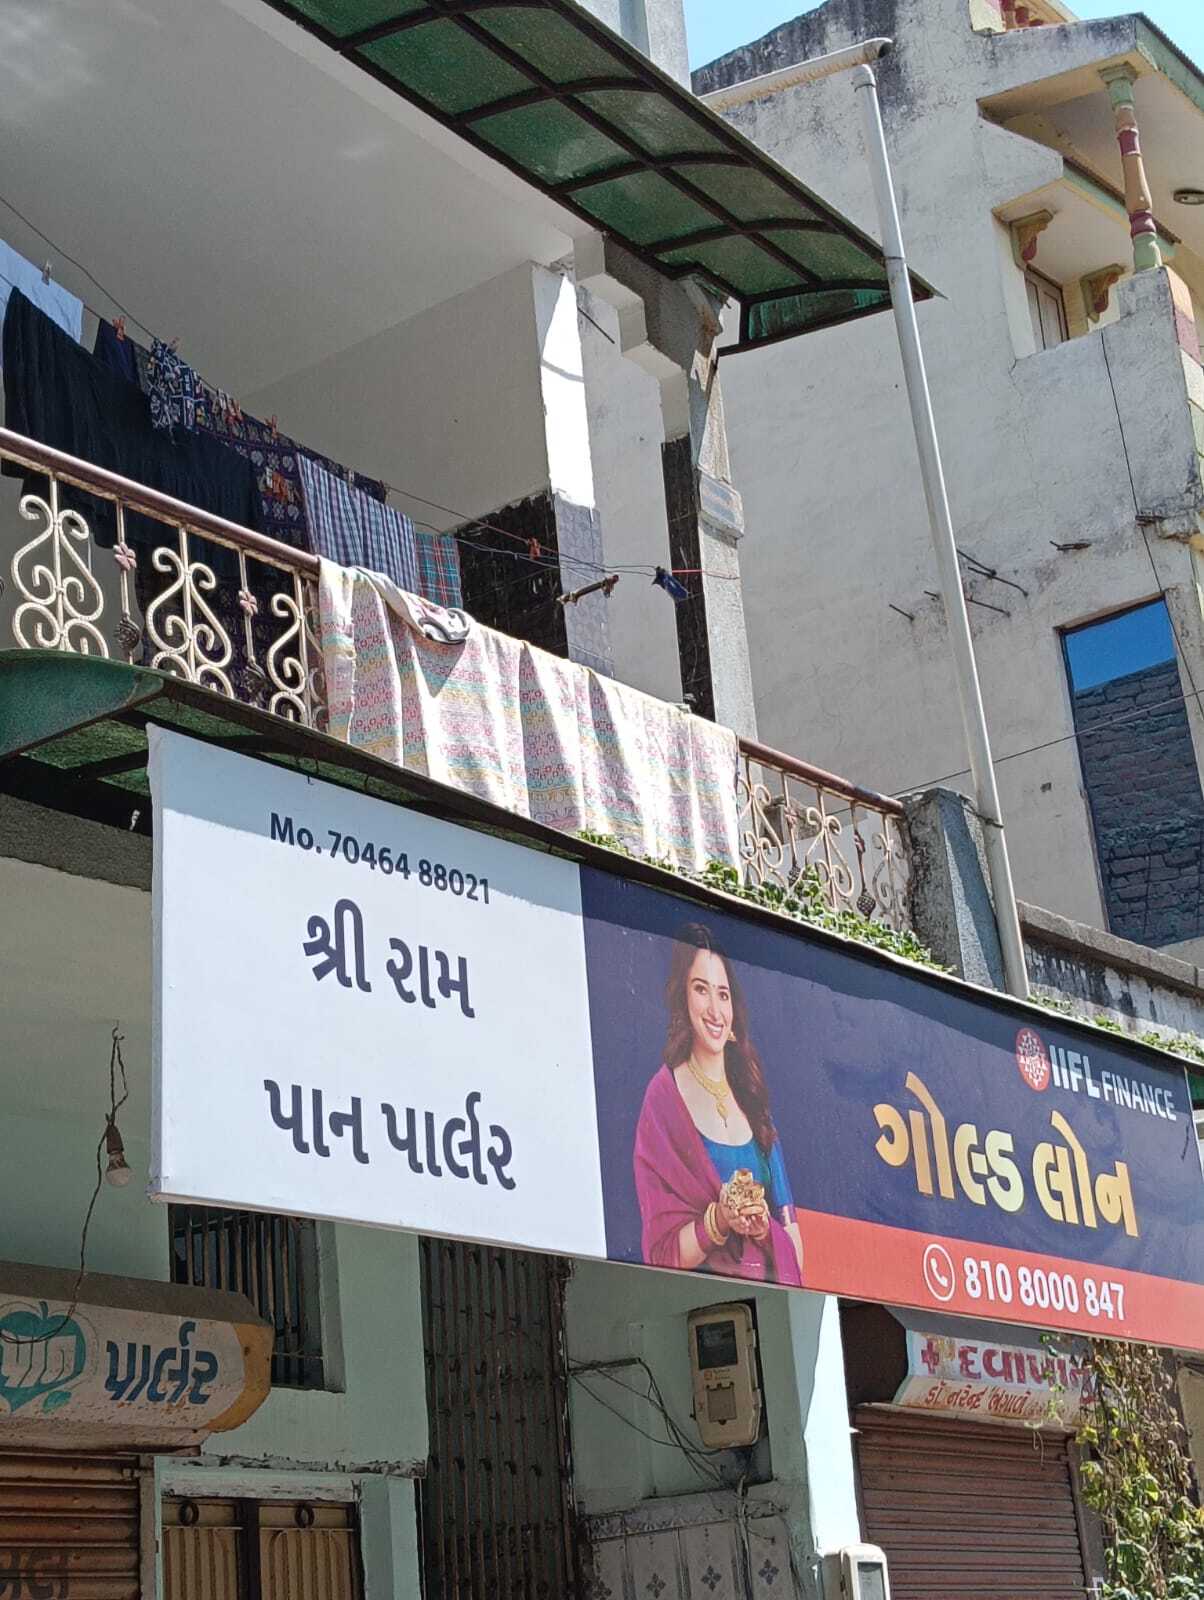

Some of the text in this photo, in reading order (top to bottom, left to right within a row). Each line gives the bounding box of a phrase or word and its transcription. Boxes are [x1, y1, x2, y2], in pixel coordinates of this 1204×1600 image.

[270, 812, 490, 903] Mo. 70464 88021
[302, 898, 476, 1019] શ્રી રામ
[1050, 1045, 1177, 1121] IIFL FINANCE
[264, 1079, 517, 1190] પાન પાર્લર
[872, 1071, 1139, 1238] ગોલ્ડ લોન
[963, 1257, 1125, 1321] 810 8000 847
[104, 1321, 219, 1405] પાર્લર
